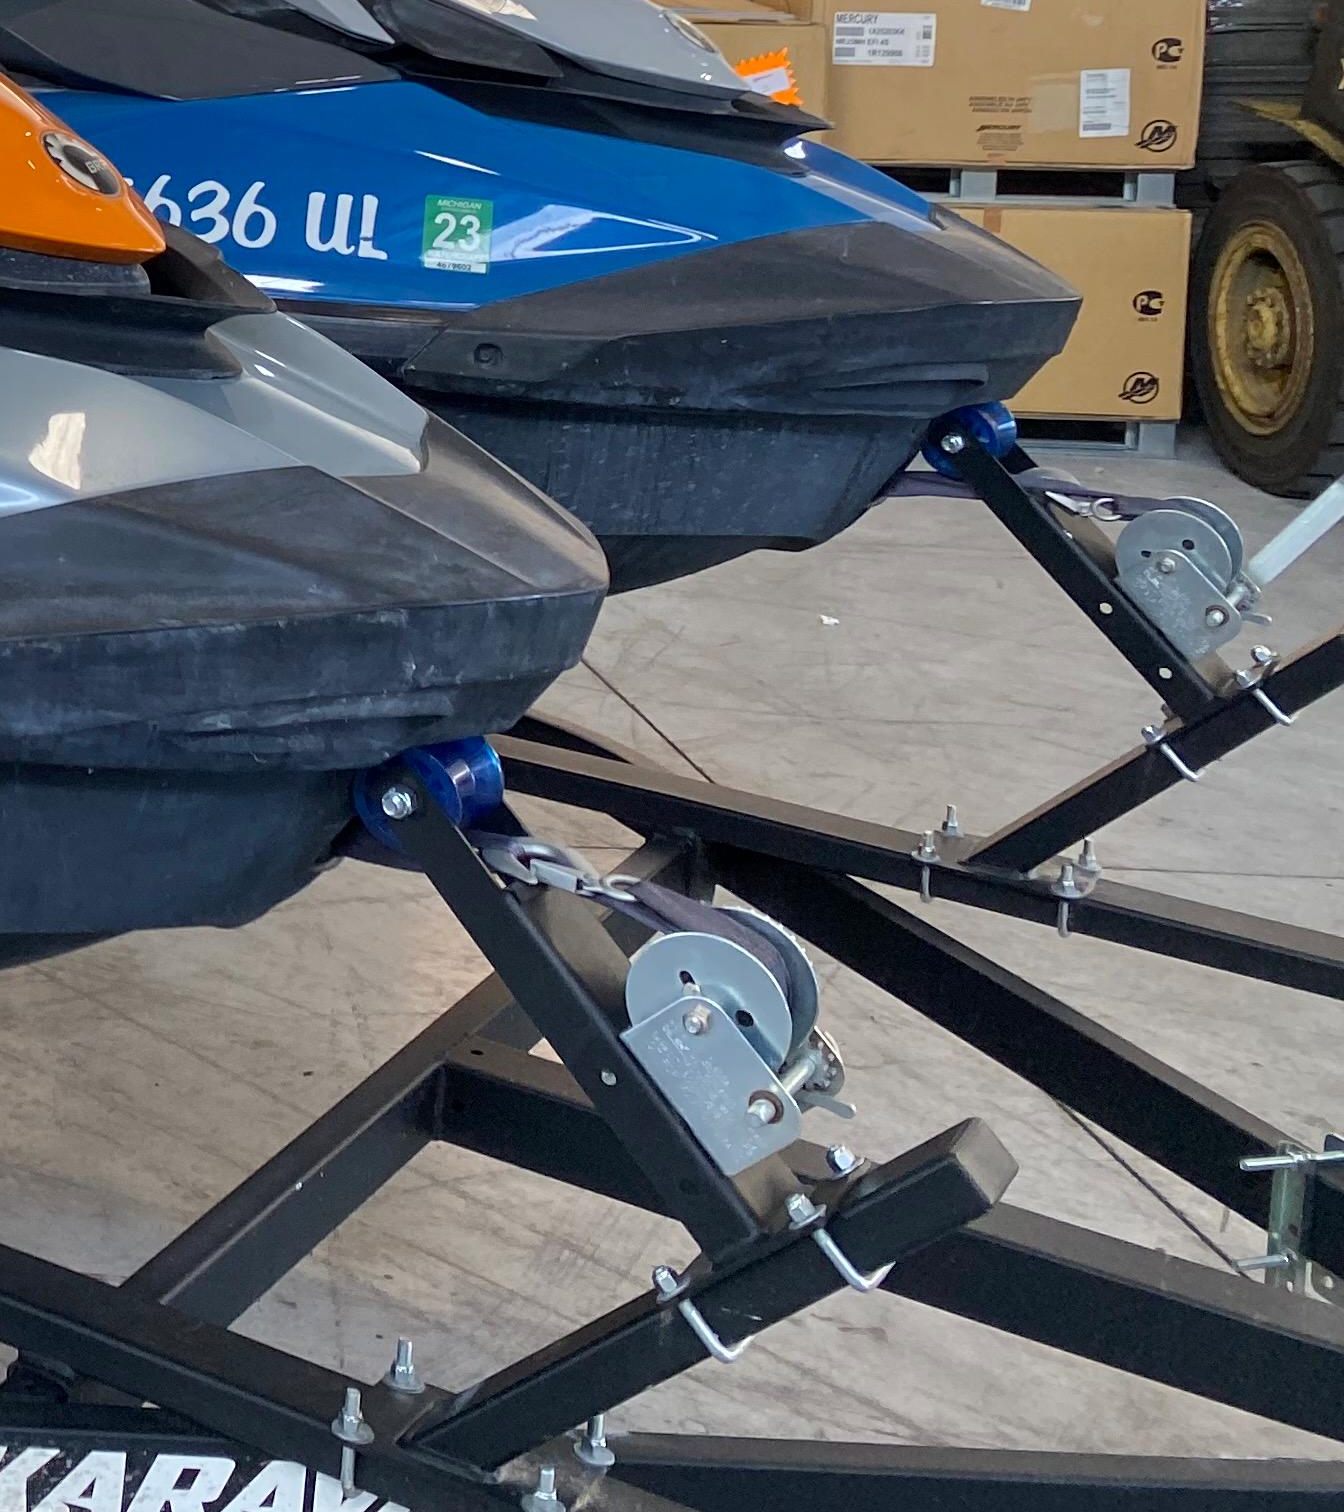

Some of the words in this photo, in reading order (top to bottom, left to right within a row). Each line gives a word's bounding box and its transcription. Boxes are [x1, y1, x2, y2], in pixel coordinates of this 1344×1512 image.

[835, 13, 879, 24] MERCURY
[123, 174, 277, 248] 636
[305, 191, 389, 260] UL
[436, 199, 483, 210] MICHIGAN
[432, 212, 481, 252] 23
